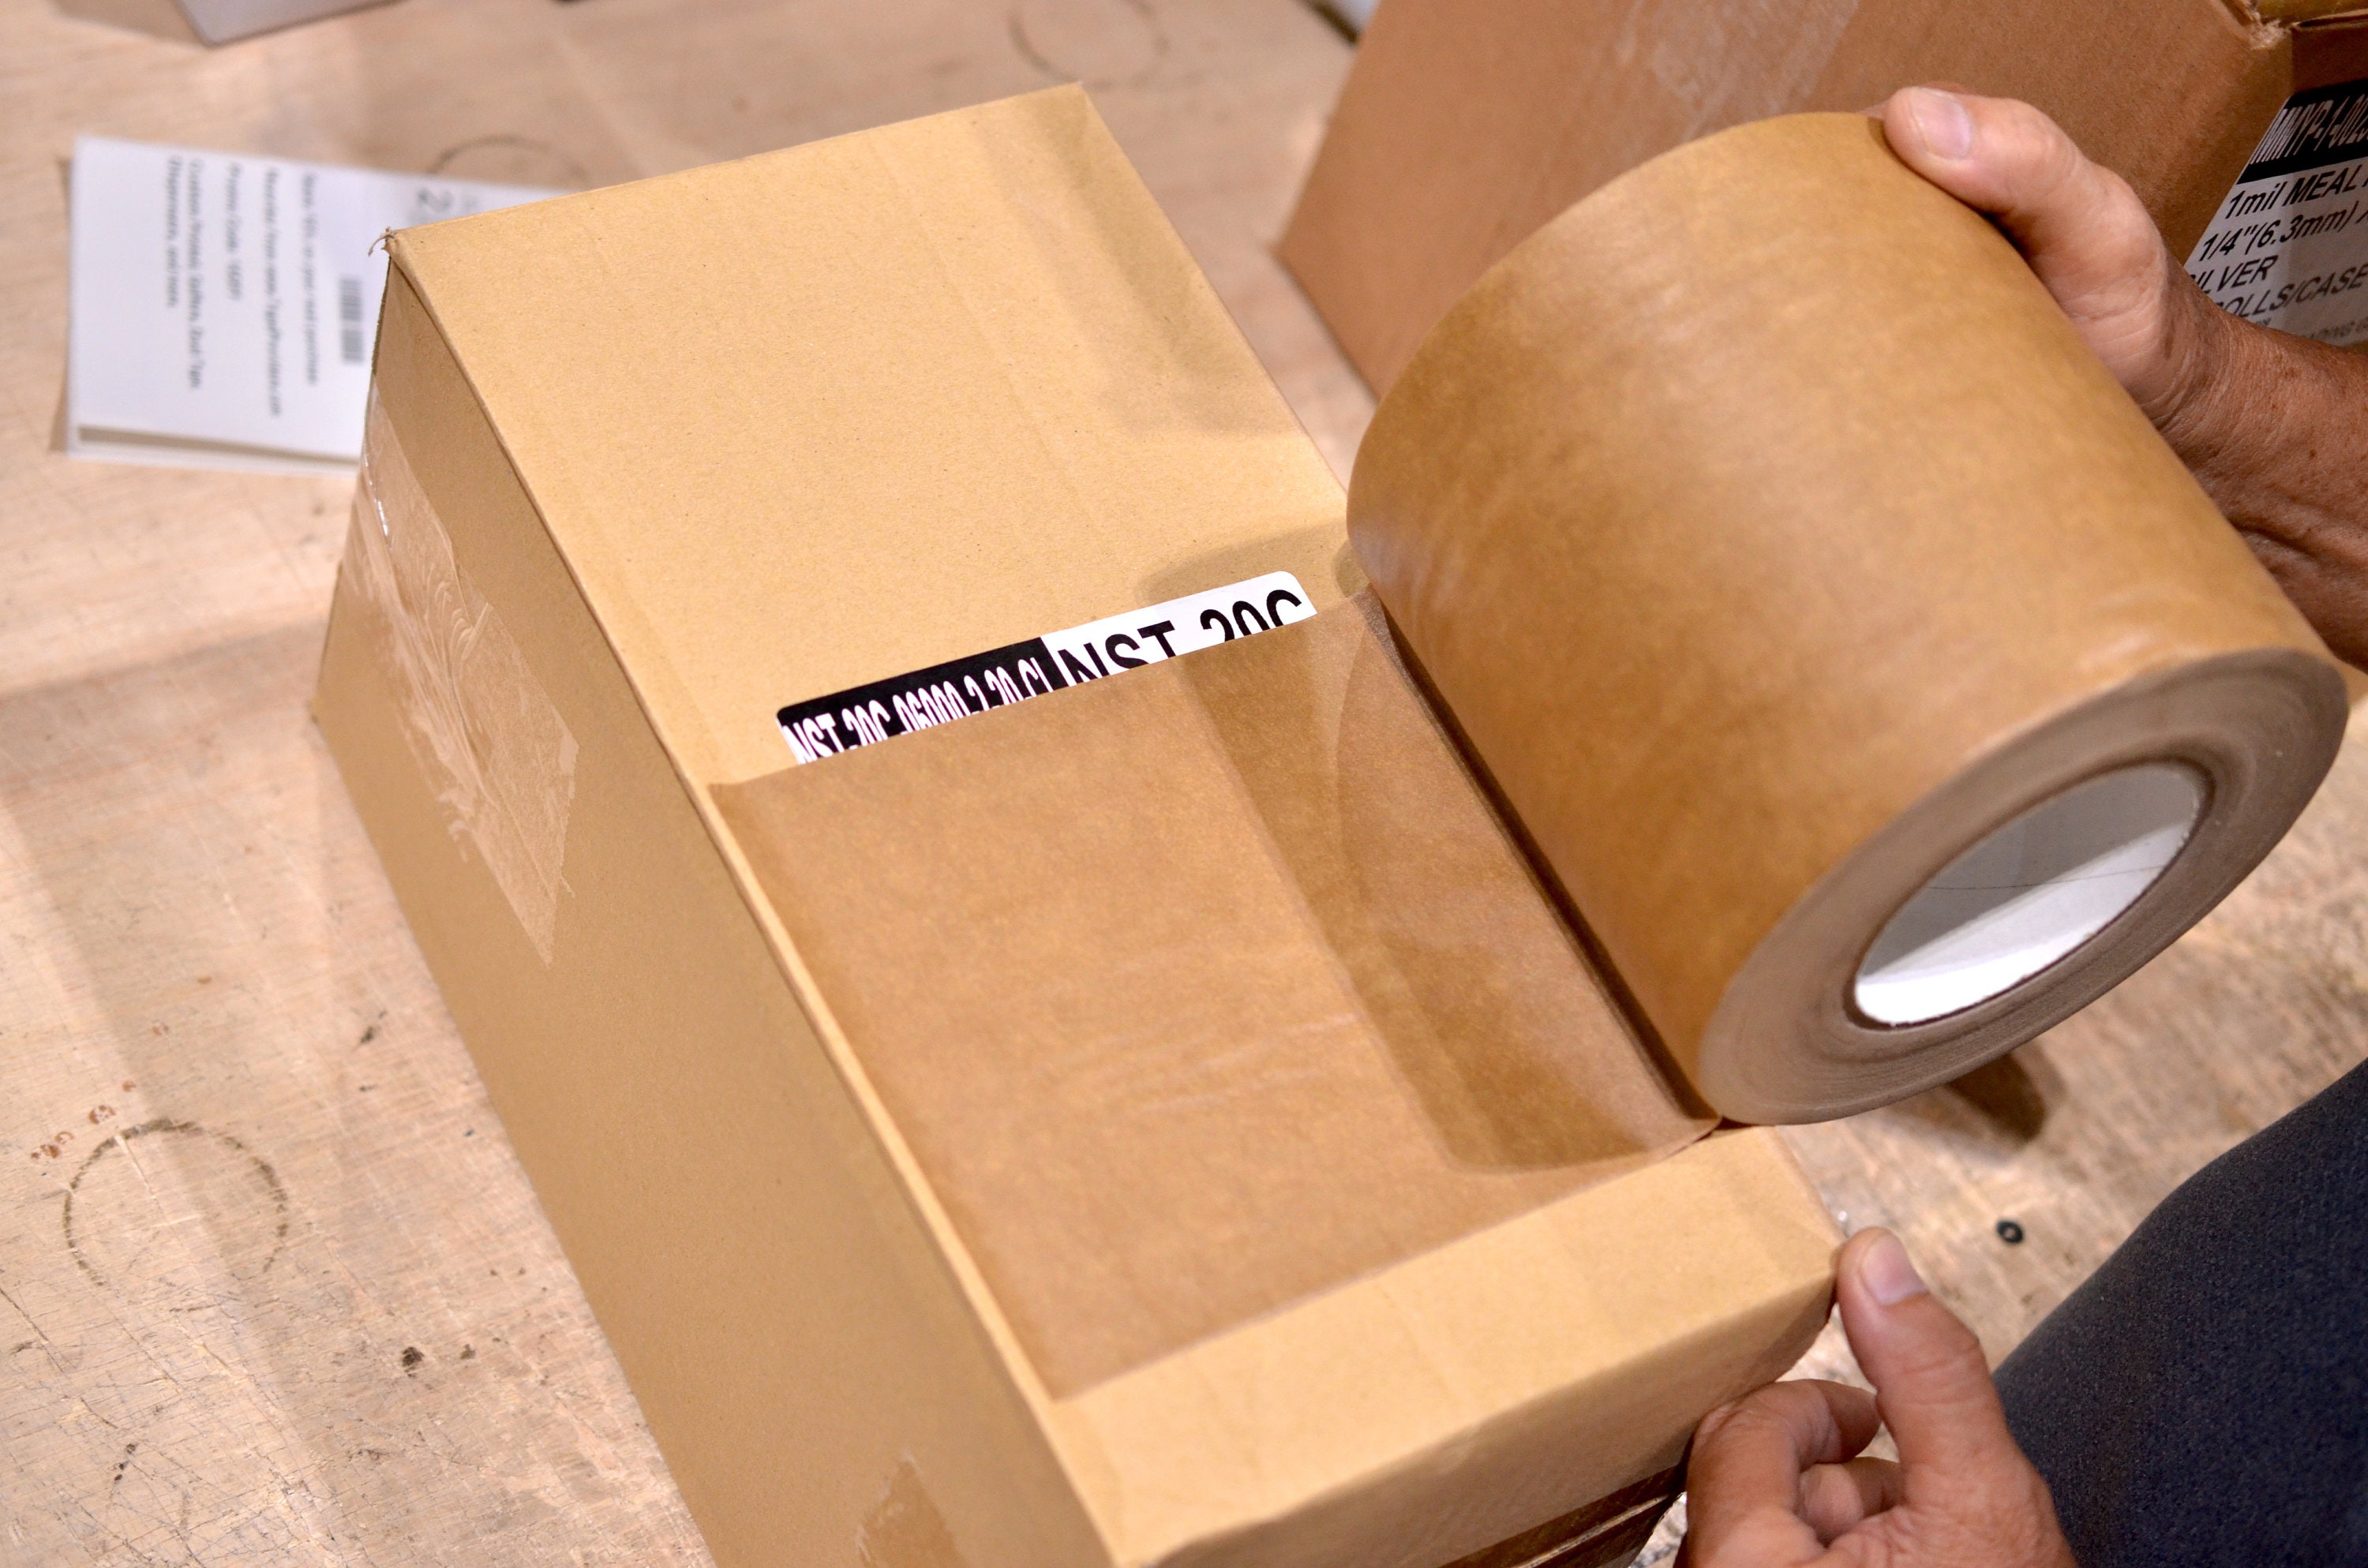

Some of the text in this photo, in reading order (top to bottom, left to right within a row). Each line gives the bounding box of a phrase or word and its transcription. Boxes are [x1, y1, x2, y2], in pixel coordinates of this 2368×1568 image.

[2225, 163, 2363, 219] 1mil MEAL
[2216, 264, 2368, 317] OLLS/CASE
